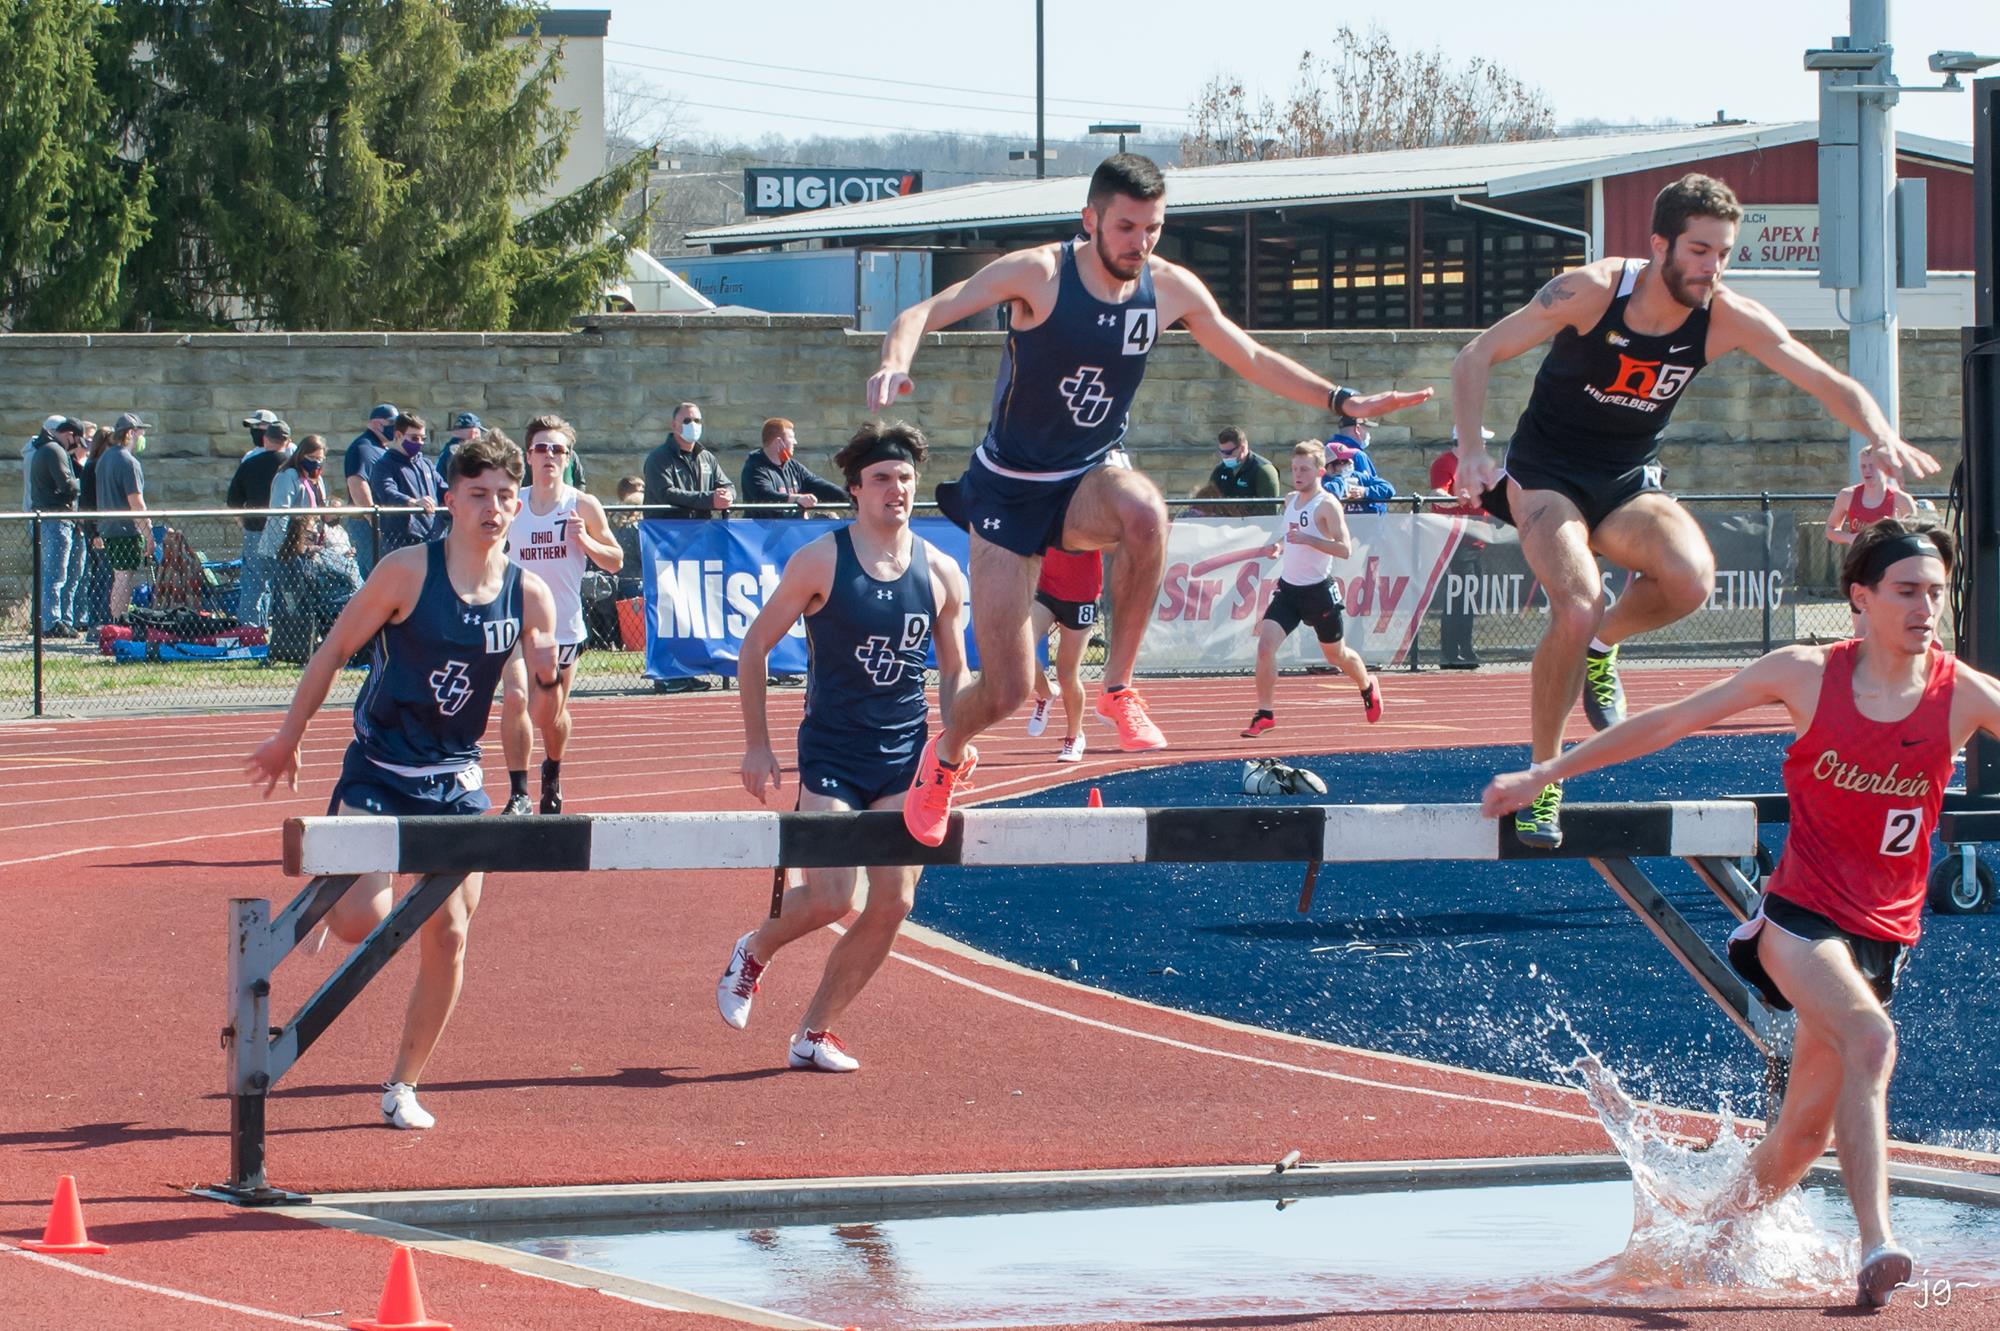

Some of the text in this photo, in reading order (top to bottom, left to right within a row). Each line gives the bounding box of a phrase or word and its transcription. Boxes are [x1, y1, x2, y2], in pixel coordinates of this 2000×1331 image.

[1758, 226, 1805, 242] APEX
[1738, 246, 1752, 262] &
[1128, 312, 1150, 351] 4
[1657, 368, 1687, 397] 5
[1584, 384, 1661, 413] HEIDELBER
[554, 519, 568, 541] 7
[1300, 510, 1309, 528] 6
[531, 531, 553, 545] OHIO
[520, 545, 567, 561] NORTHERN
[655, 559, 806, 639] Mist
[1158, 556, 1410, 637] Sir Spdy
[1446, 574, 1525, 615] PRINT
[1081, 606, 1091, 622] 8
[487, 621, 515, 651] 10
[904, 616, 926, 648] 9
[563, 644, 576, 662] 7
[1813, 749, 1930, 797] Otterbein
[1885, 813, 1917, 853] 2
